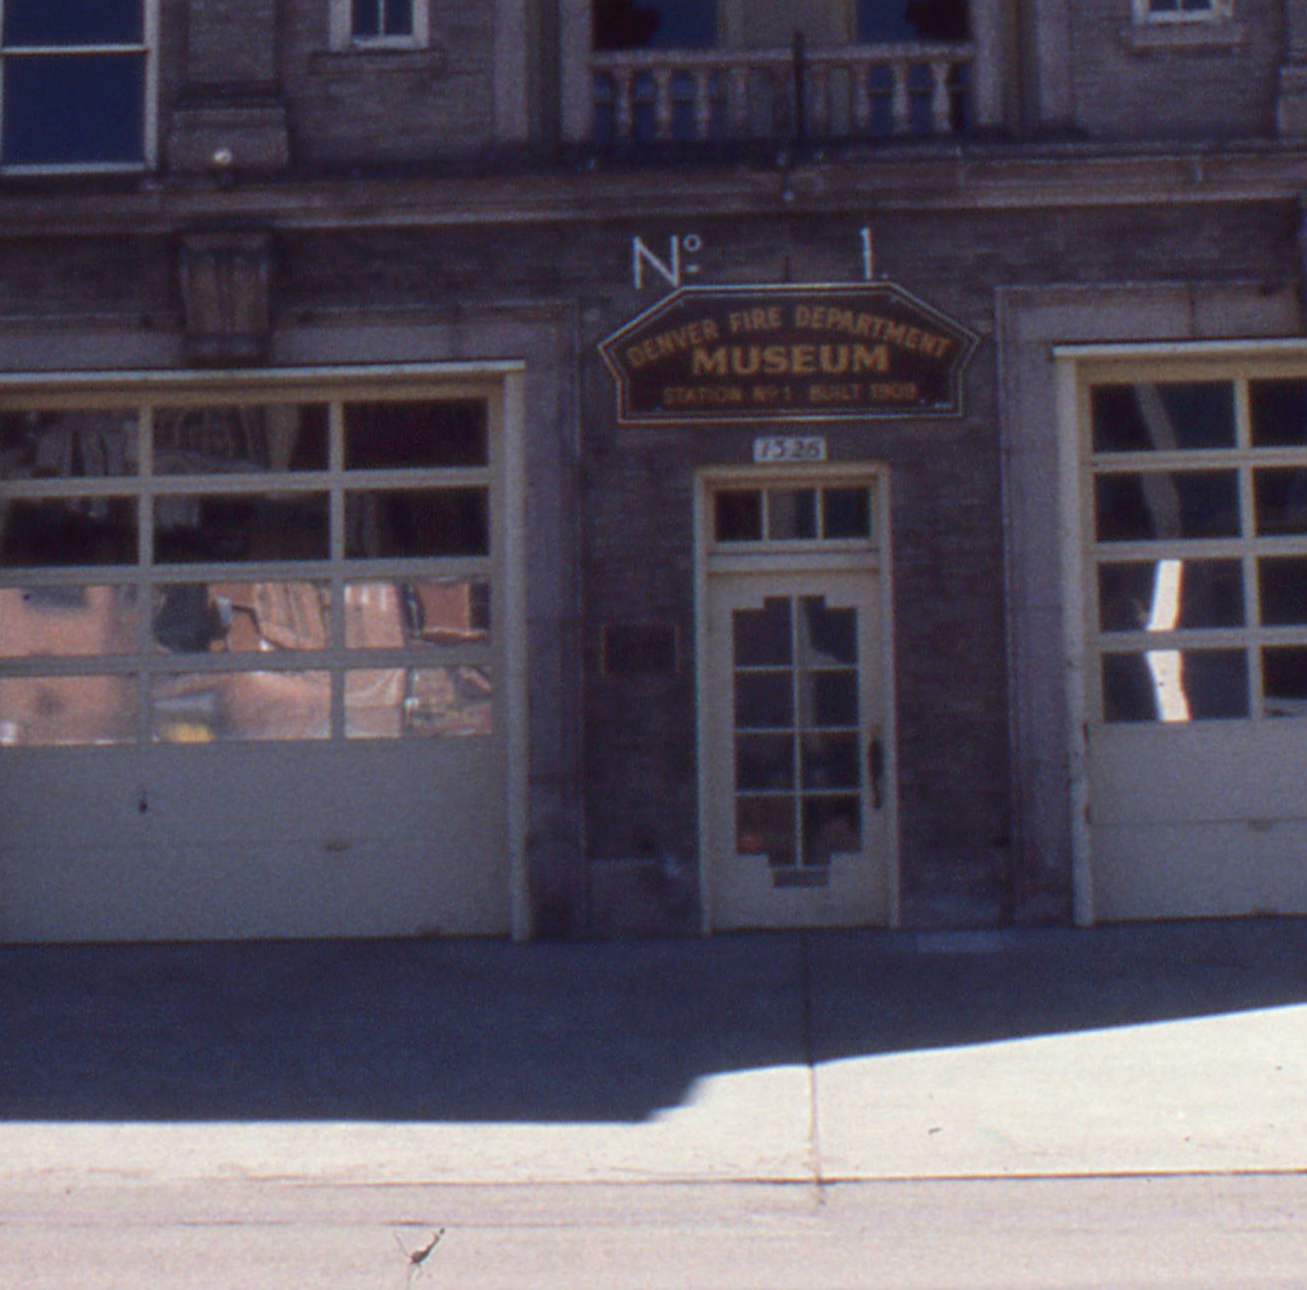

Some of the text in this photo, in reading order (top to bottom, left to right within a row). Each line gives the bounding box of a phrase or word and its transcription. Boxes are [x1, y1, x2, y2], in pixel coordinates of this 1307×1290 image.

[627, 305, 951, 368] DENVER FIRE DEPARTMENT
[692, 344, 890, 376] MUSEUM
[662, 386, 742, 406] STATION
[809, 383, 862, 402] BUILT
[760, 438, 821, 460] 1526
